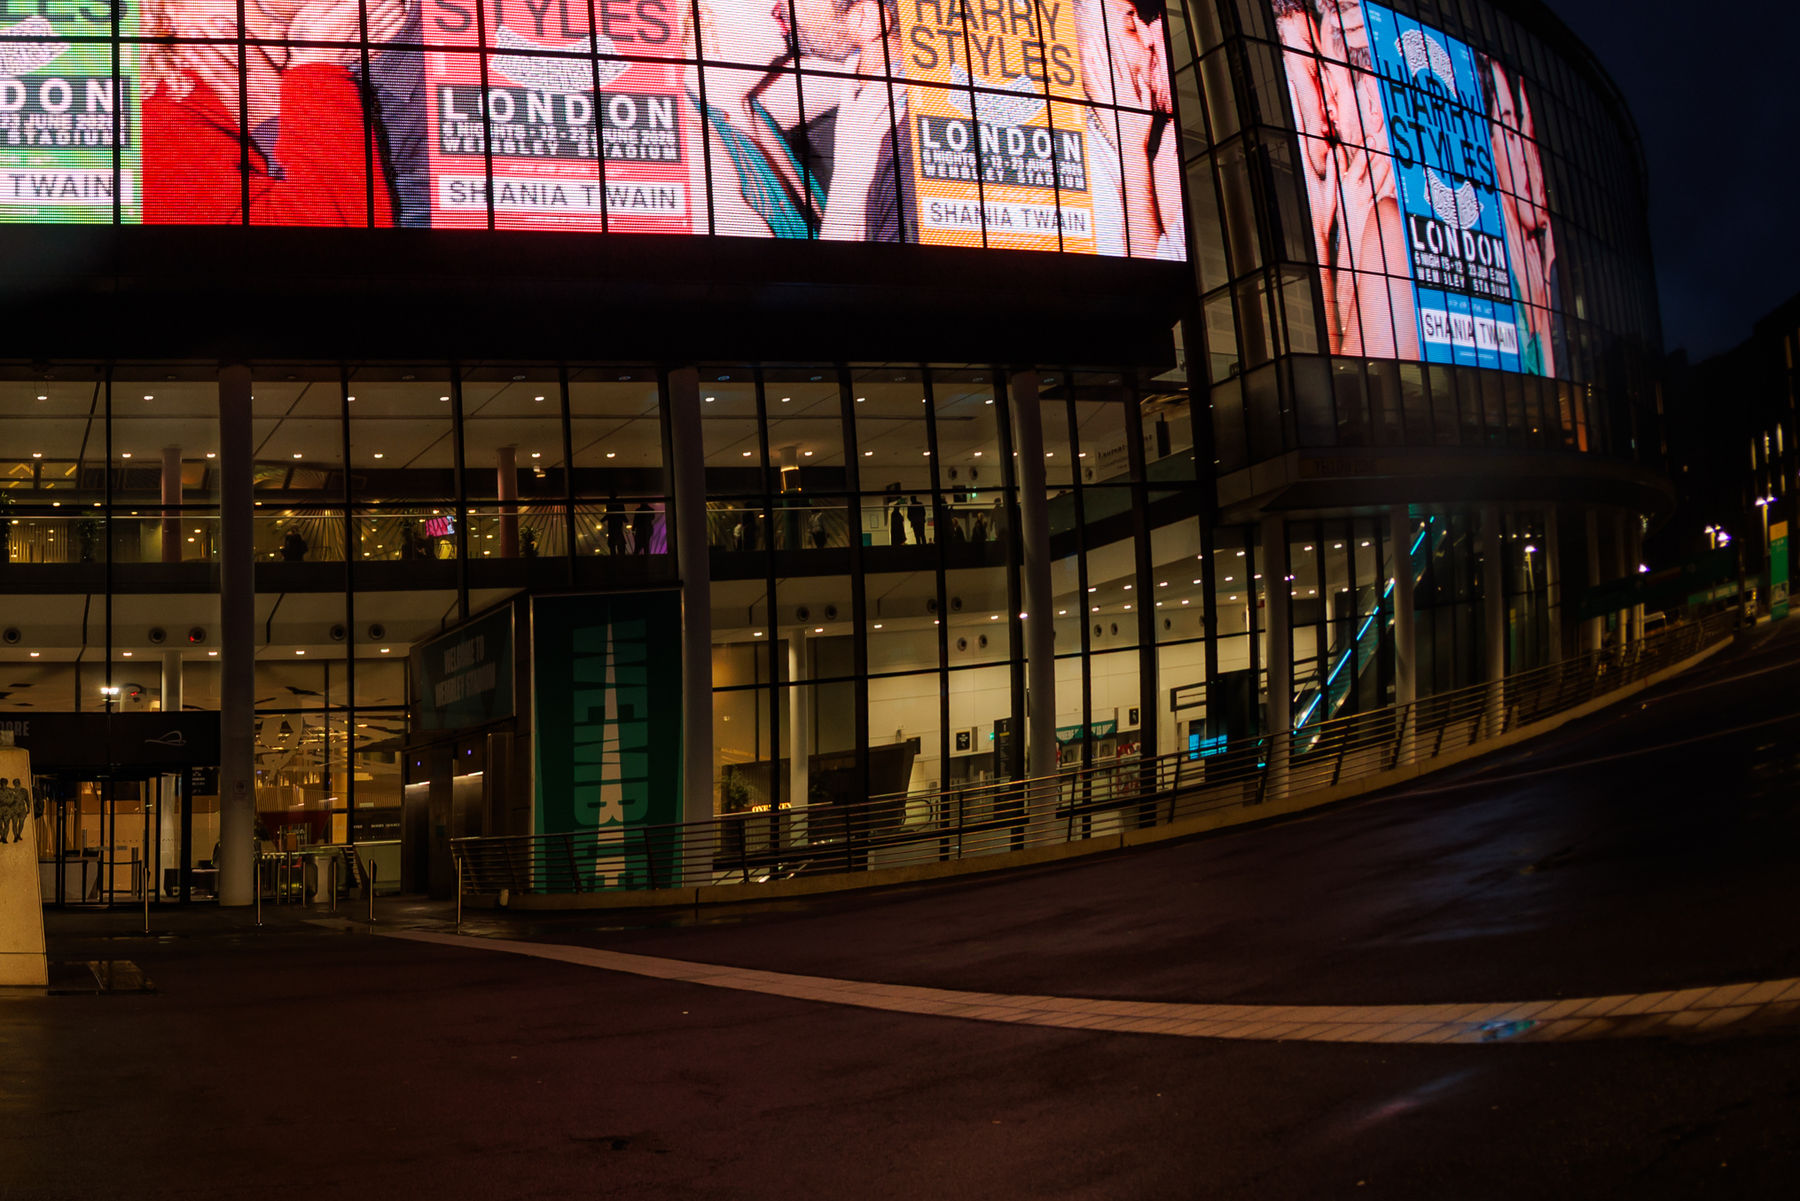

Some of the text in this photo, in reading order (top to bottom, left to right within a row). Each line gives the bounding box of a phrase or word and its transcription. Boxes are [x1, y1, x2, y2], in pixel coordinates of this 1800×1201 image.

[910, 25, 1075, 86] STYLES
[443, 88, 672, 128] LONDON
[1384, 60, 1478, 142] HARRY
[8, 129, 125, 145] STADIUM
[25, 114, 74, 129] JUNE
[457, 123, 526, 138] NIGHTS
[591, 128, 638, 144] JUNE
[442, 138, 677, 159] WEMBLEY STADIUM
[922, 118, 1081, 162] LONDON
[1392, 115, 1494, 195] STYLES
[9, 174, 114, 197] TWAIN
[924, 164, 1086, 188] WEMBLEY STADIUM
[450, 181, 676, 209] SHANIA TWAIN
[930, 202, 1085, 231] SHANIA TWAIN
[1410, 216, 1506, 269] LONDON
[1425, 313, 1516, 349] SHANIA TWAIN
[571, 618, 648, 893] WEMBLE
